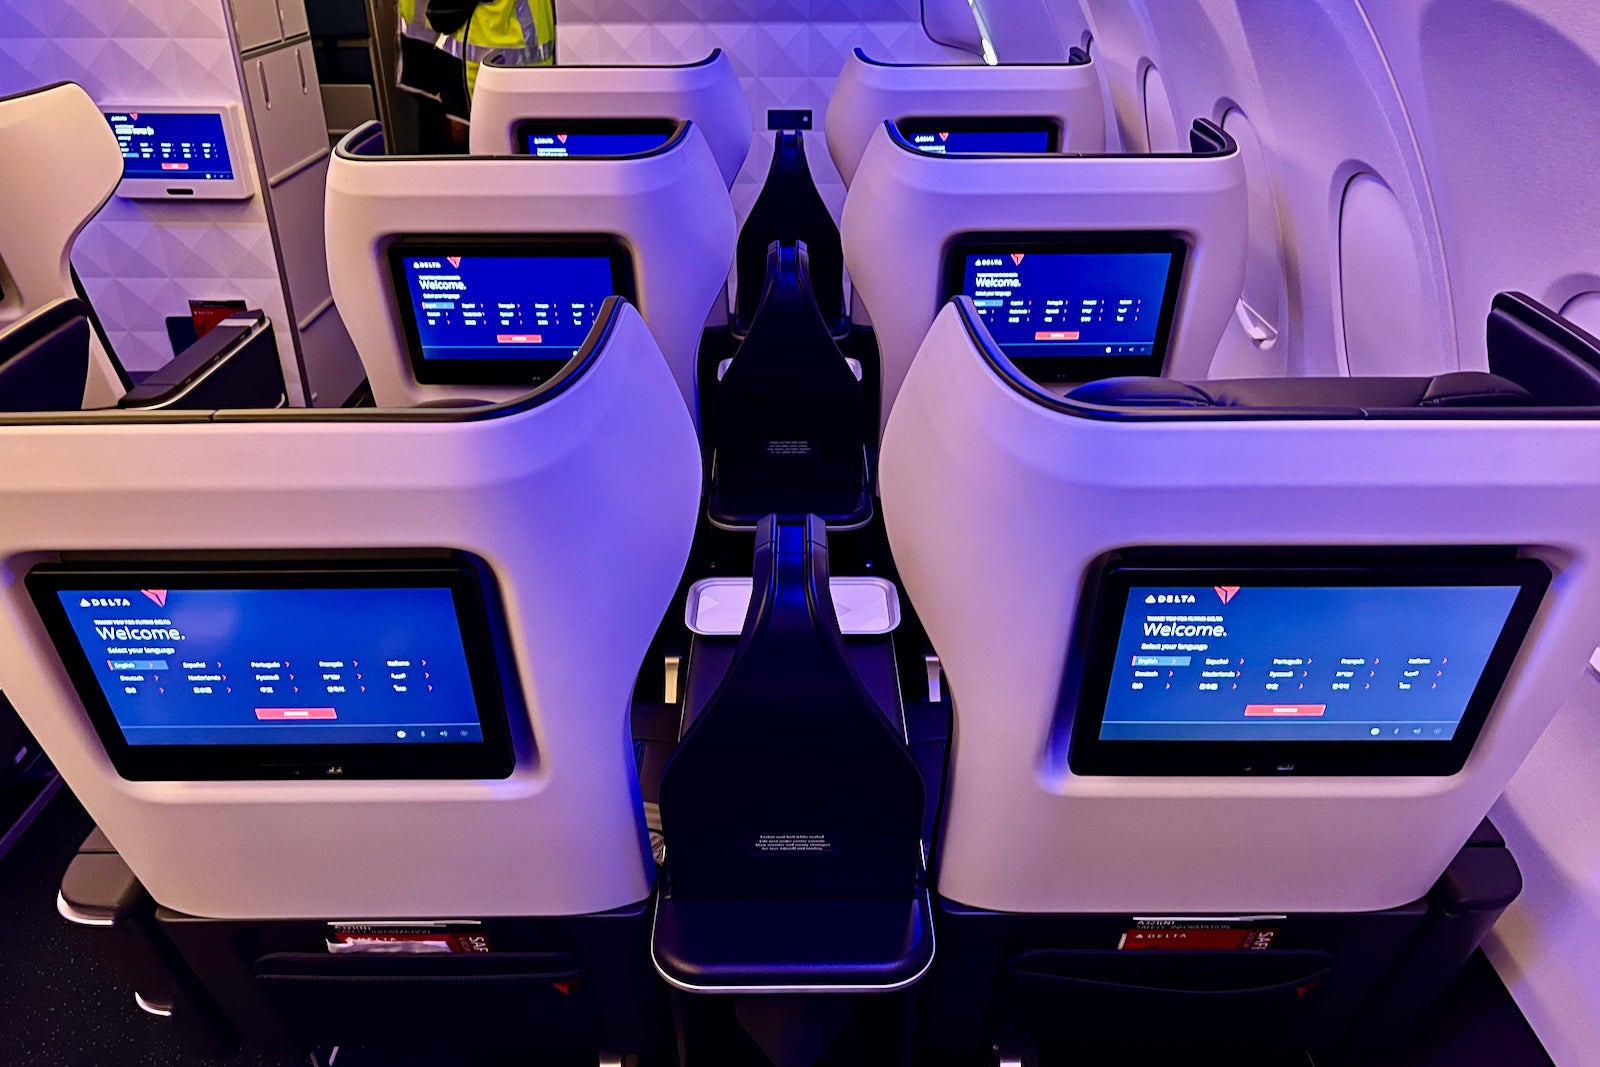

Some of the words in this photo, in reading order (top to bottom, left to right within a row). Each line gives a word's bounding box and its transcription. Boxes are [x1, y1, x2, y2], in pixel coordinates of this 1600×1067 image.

[418, 279, 467, 290] Welcome.
[975, 276, 1021, 288] Welcome.
[91, 598, 131, 607] DELTA
[1158, 594, 1196, 604] DELTA
[95, 625, 186, 641] Welcome.
[1143, 621, 1227, 637] Welcome.
[107, 646, 128, 654] Select
[128, 647, 143, 655] your
[143, 646, 176, 655] language
[1161, 644, 1177, 652] your
[1177, 643, 1209, 652] language
[1137, 657, 1159, 666] English
